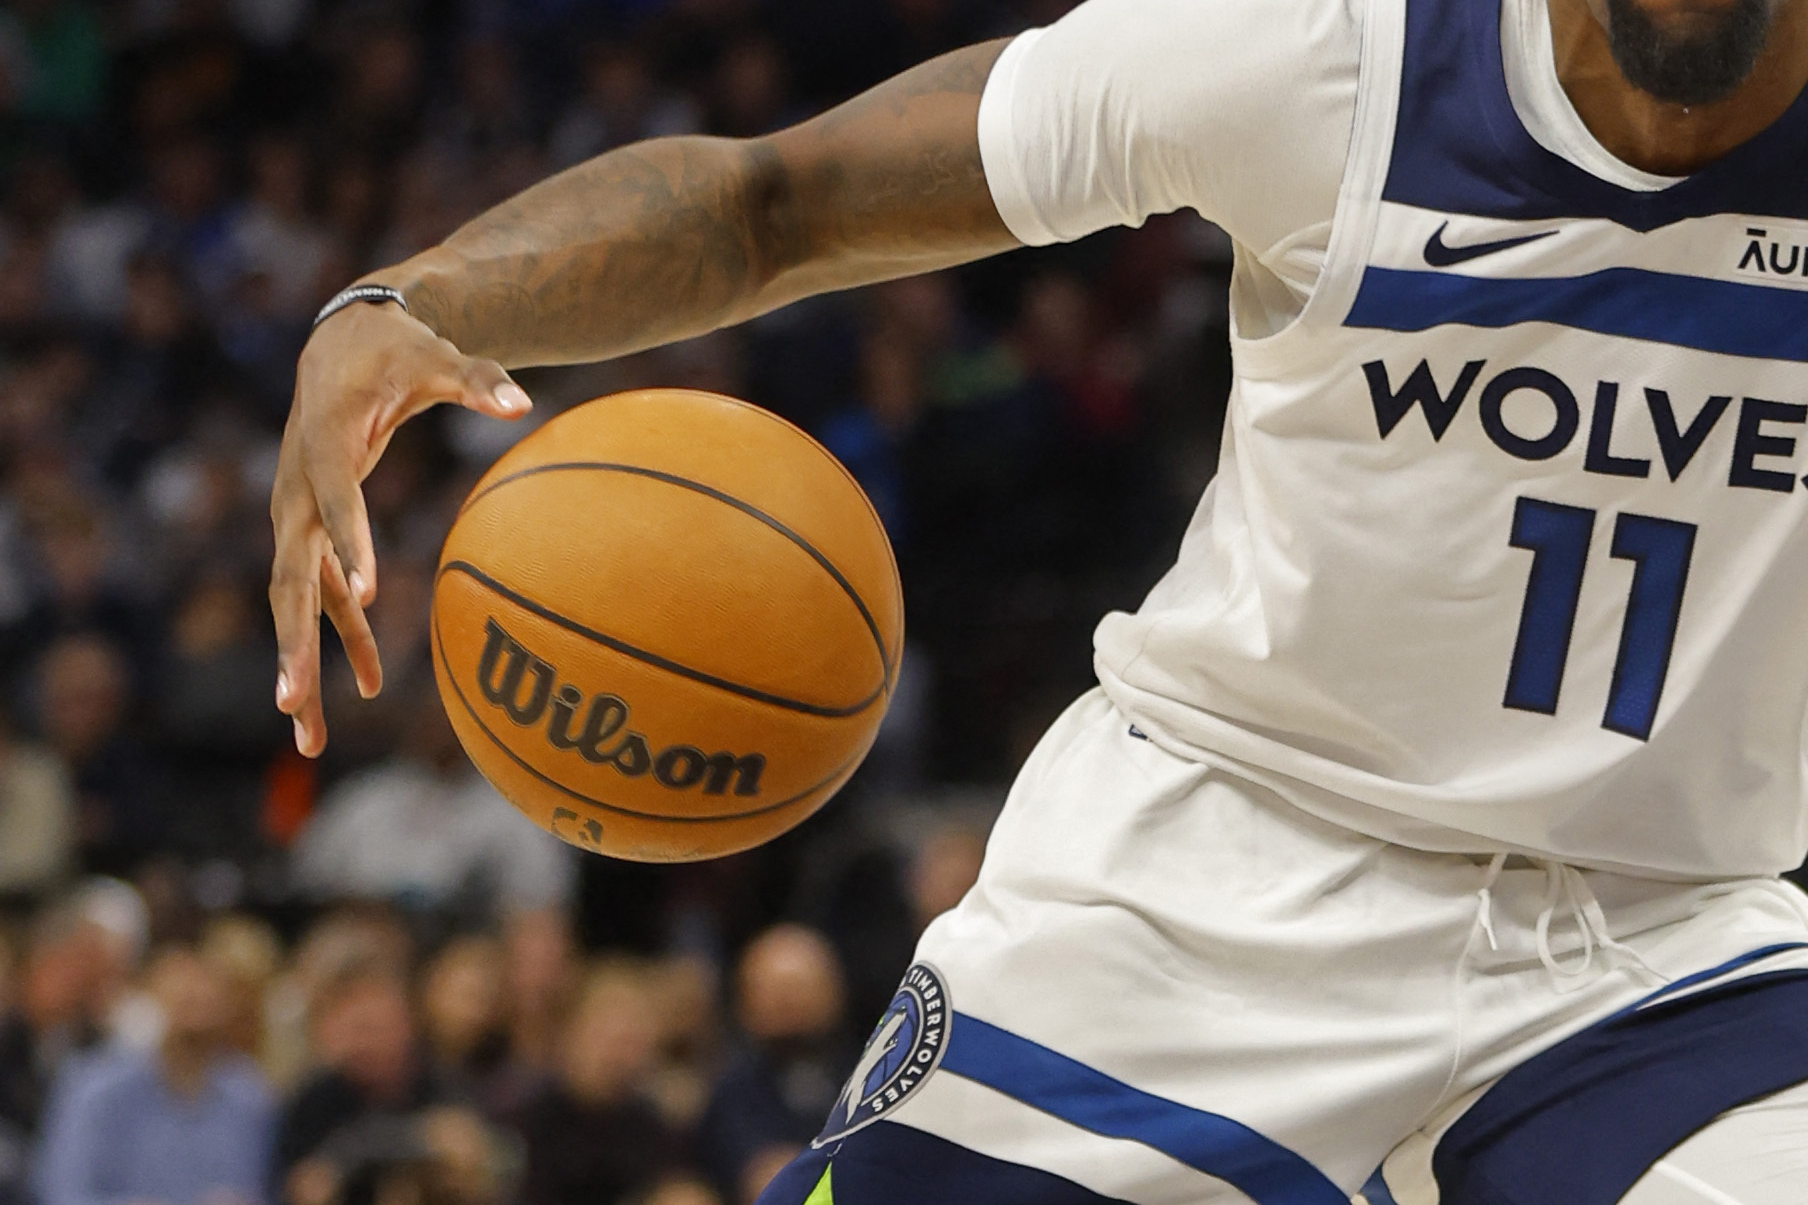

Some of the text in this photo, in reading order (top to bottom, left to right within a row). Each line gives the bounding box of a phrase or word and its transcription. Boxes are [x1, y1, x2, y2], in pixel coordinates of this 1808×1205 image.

[477, 616, 767, 796] Wilson
[1503, 496, 1698, 742] 11
[872, 968, 942, 1112] TIMBERWOLVES
